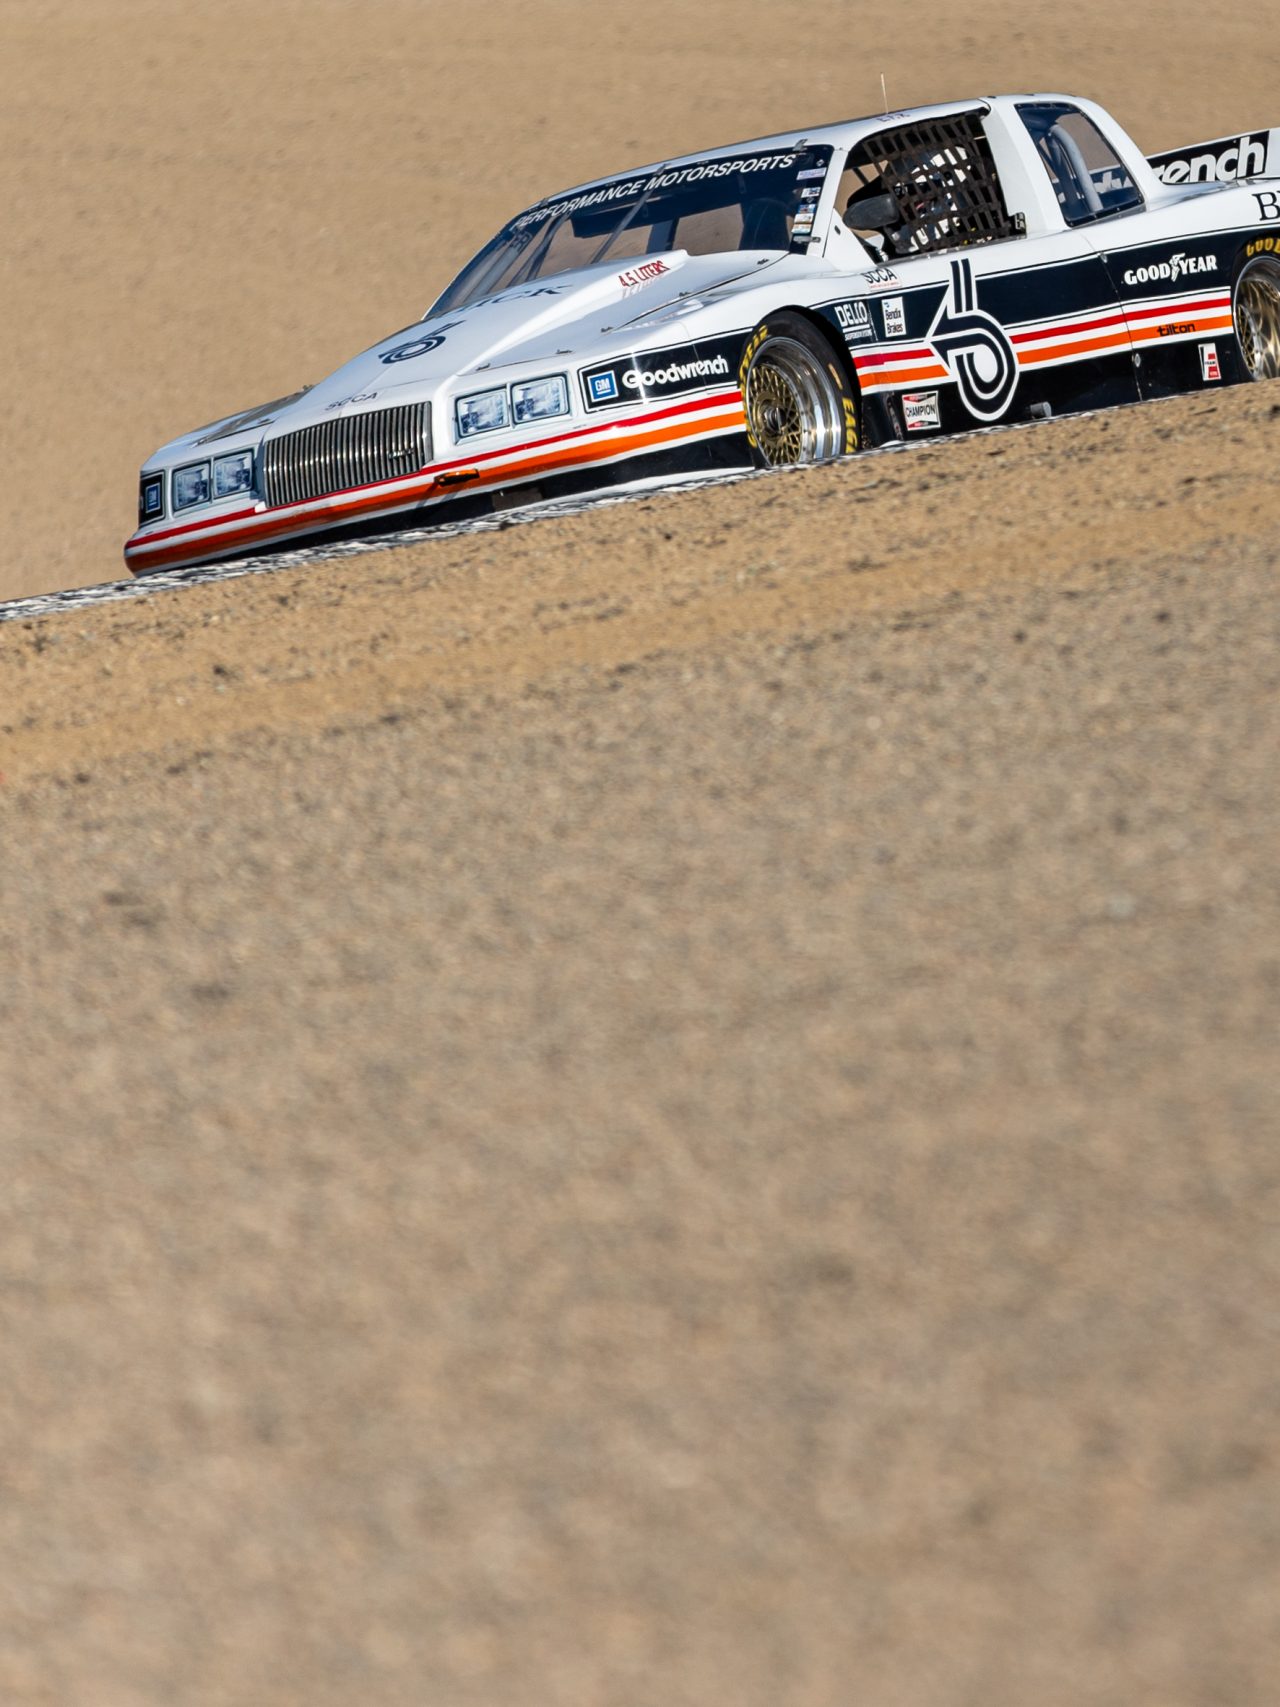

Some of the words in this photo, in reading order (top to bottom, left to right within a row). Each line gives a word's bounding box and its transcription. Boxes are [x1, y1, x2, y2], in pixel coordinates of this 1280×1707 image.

[508, 178, 647, 232] PERFORMANCE
[644, 153, 797, 190] MOTORSPORTS
[633, 260, 671, 281] LITERS
[860, 267, 897, 284] SCCA
[834, 301, 868, 328] DELCO
[887, 322, 904, 334] Brakes
[1157, 322, 1195, 337] tilton
[595, 376, 611, 392] GM
[621, 355, 730, 389] Goodwrench
[905, 404, 936, 417] CHAMPION
